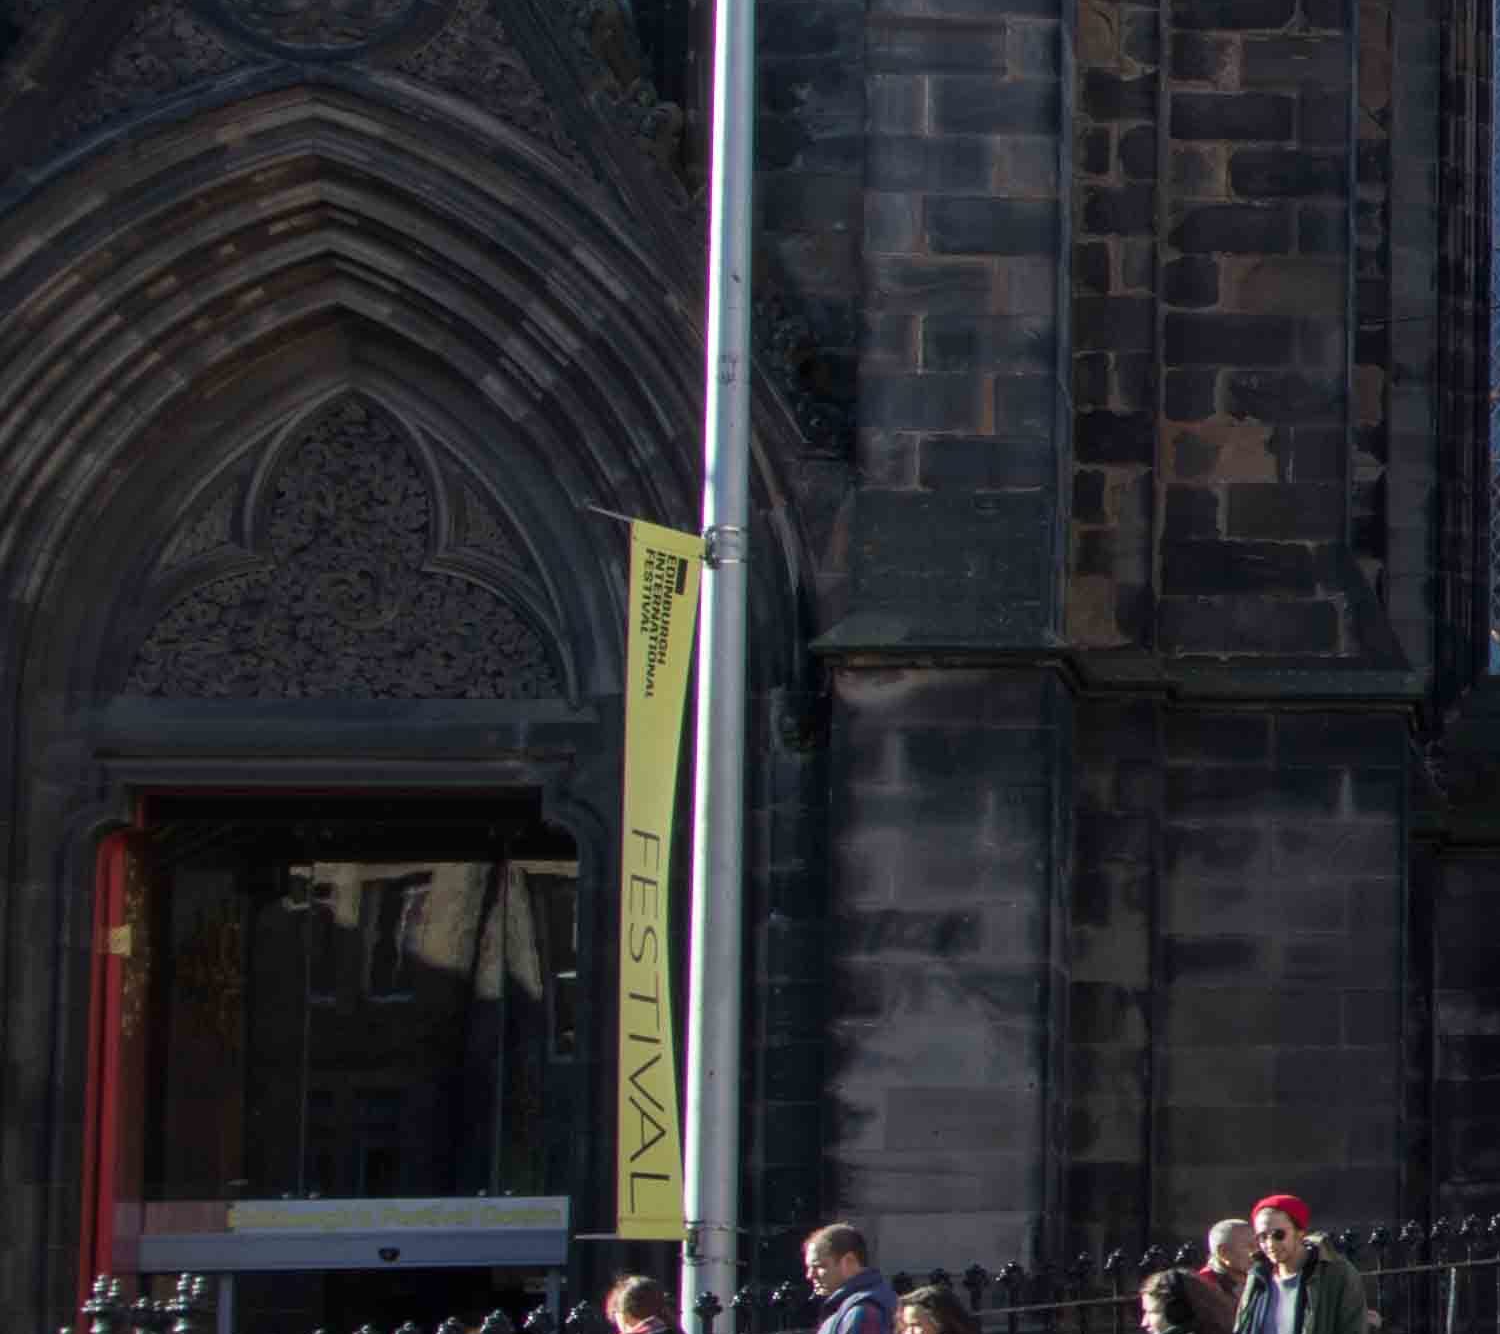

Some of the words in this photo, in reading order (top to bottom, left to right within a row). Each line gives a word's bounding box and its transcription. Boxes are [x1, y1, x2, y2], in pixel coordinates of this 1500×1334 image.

[640, 547, 657, 635] FESTIVAL
[645, 549, 667, 698] INTERNATIONAL
[658, 553, 678, 666] EDINBURGH
[628, 828, 672, 1215] FESTIVAL
